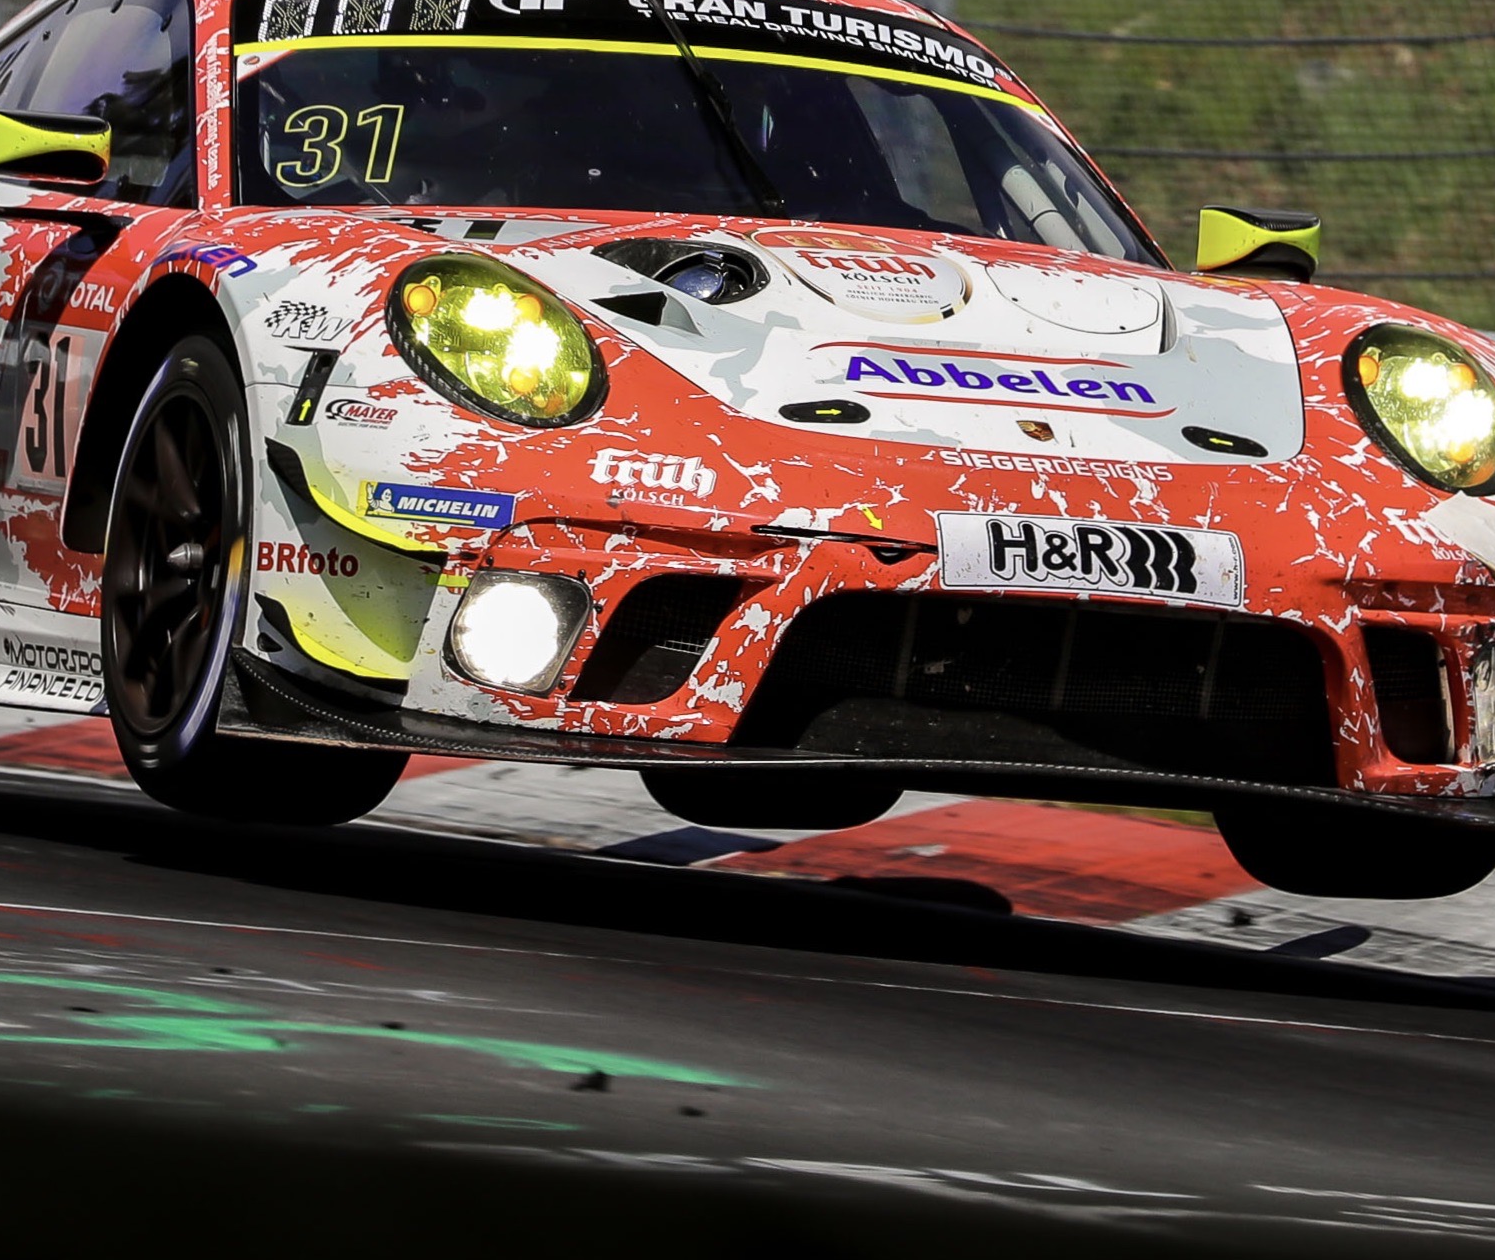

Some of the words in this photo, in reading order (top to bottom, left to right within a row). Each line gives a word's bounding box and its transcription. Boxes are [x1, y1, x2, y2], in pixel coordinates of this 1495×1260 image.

[694, 13, 761, 29] REAL
[764, 22, 865, 47] DRIVING
[868, 41, 1003, 91] SIMULATOR
[275, 104, 405, 188] 31
[63, 271, 115, 314] TOTAL
[841, 272, 921, 285] KÖLSCH
[845, 355, 1158, 404] Abbelen
[23, 332, 72, 478] 31
[343, 404, 399, 421] MAYER
[939, 449, 1174, 482] SIEGERDESIGNS
[396, 495, 501, 520] MICHELIN
[611, 484, 686, 506] KÖLSCH
[255, 541, 360, 578] BRfoto
[988, 519, 1122, 578] H&R
[1431, 545, 1476, 562] KÖLSC
[9, 637, 103, 677] MOTORSPO
[0, 670, 105, 703] FINANCE.CO
